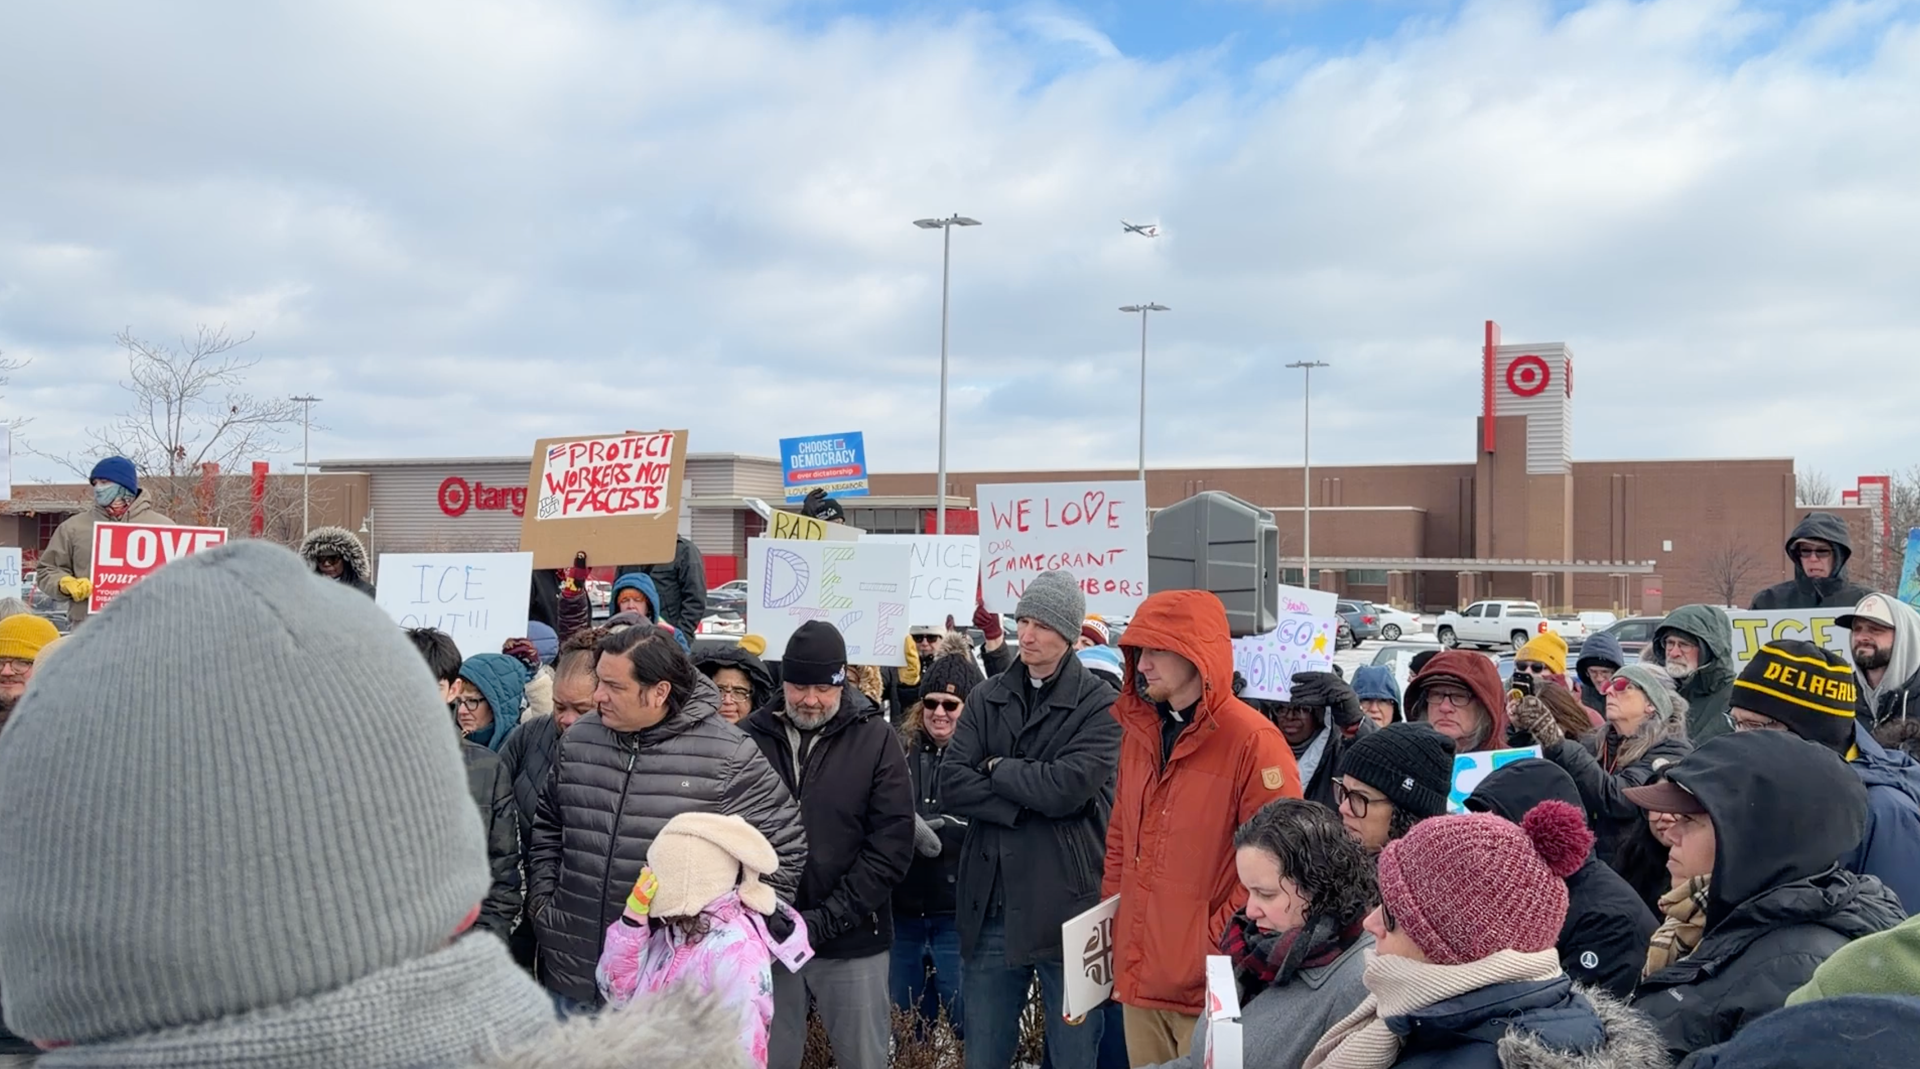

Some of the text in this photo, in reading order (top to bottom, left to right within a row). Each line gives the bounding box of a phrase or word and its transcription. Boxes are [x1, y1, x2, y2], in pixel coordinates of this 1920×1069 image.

[569, 434, 673, 468] PROTECT
[790, 449, 856, 469] DEMOCRACY
[798, 440, 834, 454] CHOOSE
[545, 461, 672, 496] WORKERS NOT
[797, 467, 854, 480] over dictatorship
[473, 481, 529, 518] targ
[562, 486, 663, 516] FASCISTS
[788, 488, 808, 496] LOVE
[991, 499, 1032, 532] WE
[910, 541, 976, 569] NICE
[988, 539, 1015, 554] OUR
[987, 549, 1127, 580] IMMIGRANT
[95, 572, 137, 588] your
[411, 564, 487, 604] ICE
[910, 574, 964, 602] ICE
[1277, 619, 1315, 647] GO
